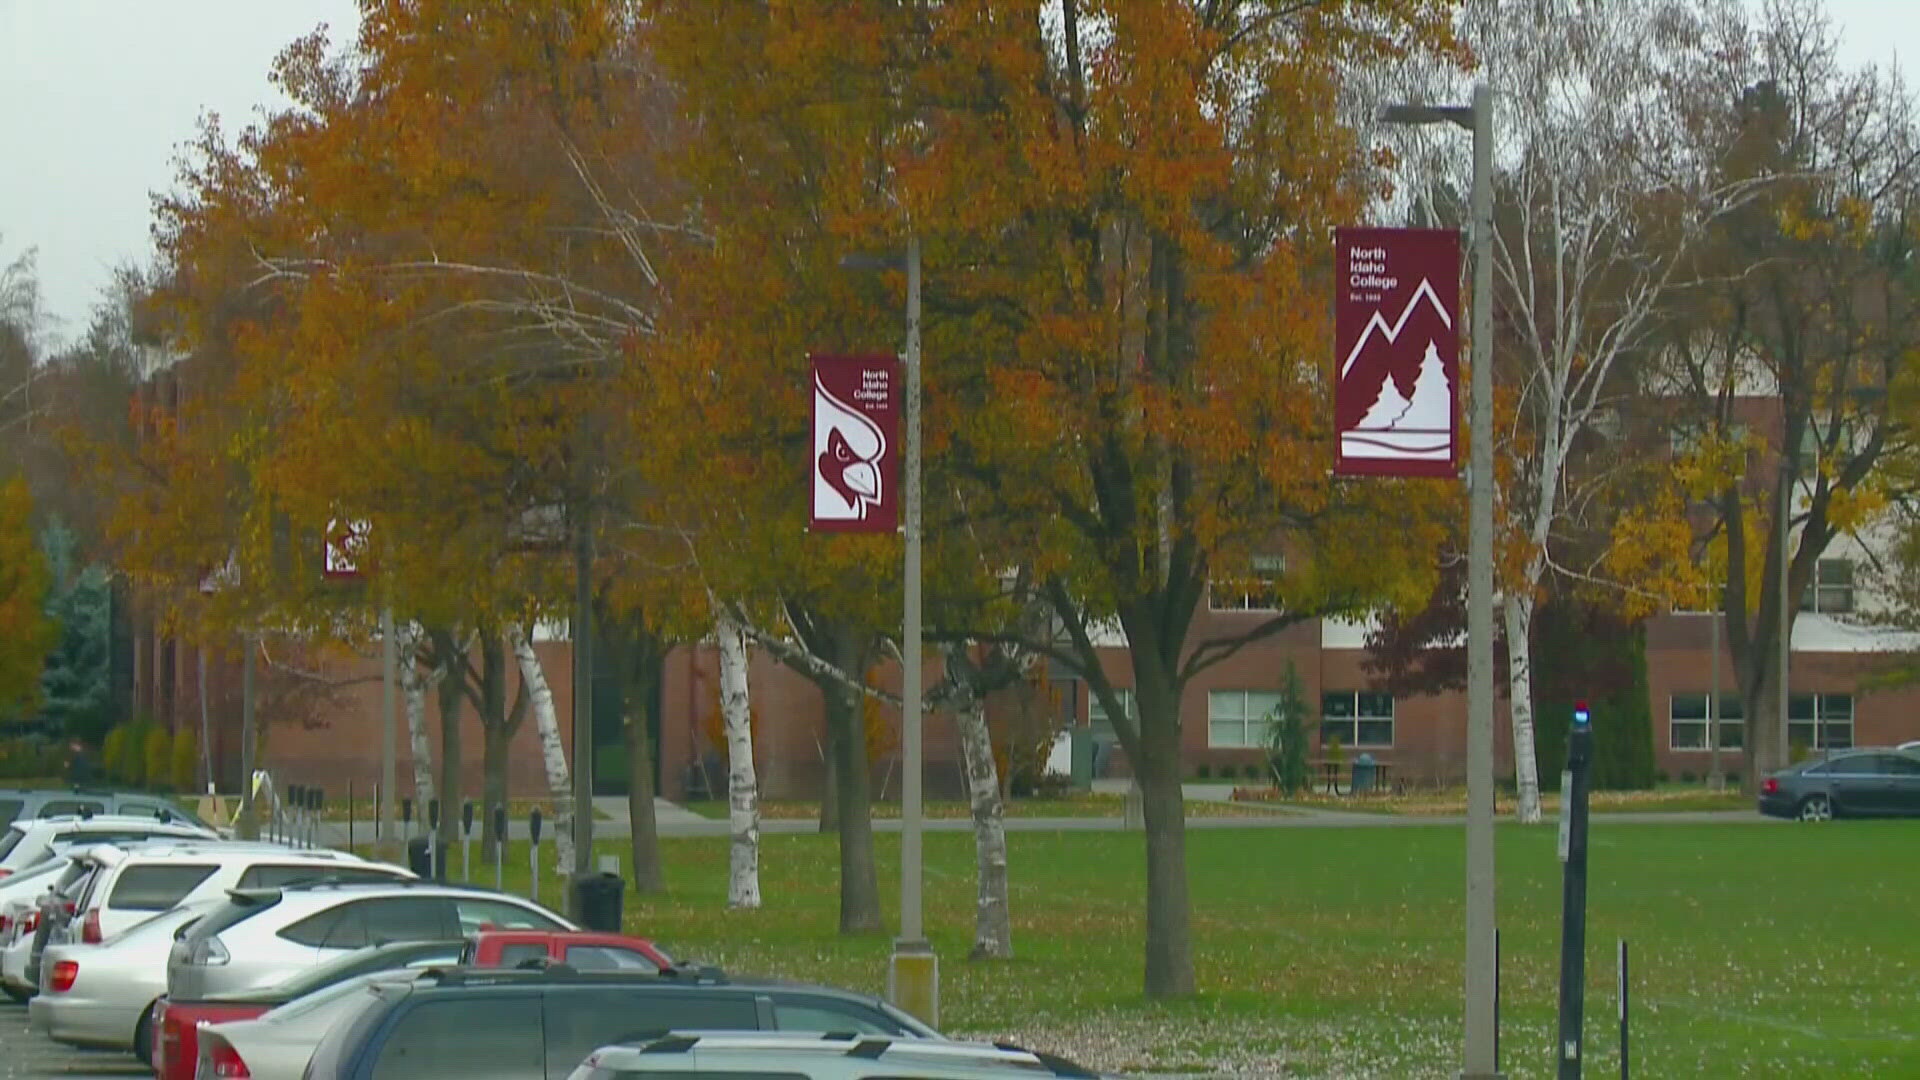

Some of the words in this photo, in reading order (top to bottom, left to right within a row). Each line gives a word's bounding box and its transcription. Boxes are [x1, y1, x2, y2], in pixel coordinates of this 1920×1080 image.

[1350, 246, 1386, 259] North
[1350, 260, 1385, 273] Idaho
[1350, 274, 1398, 289] College
[863, 369, 888, 380] North
[863, 380, 888, 389] Idaho
[853, 389, 888, 401] College
